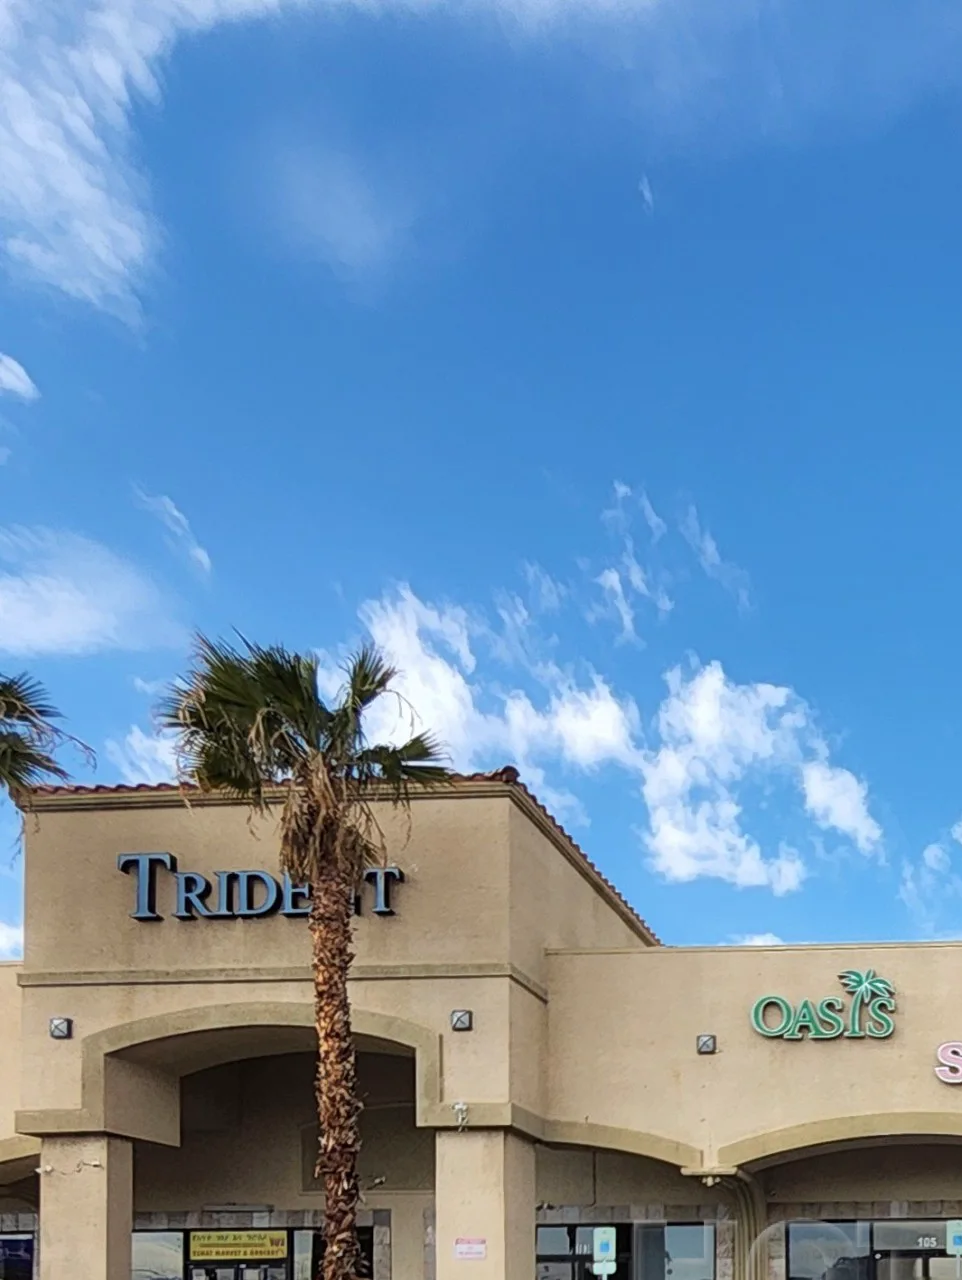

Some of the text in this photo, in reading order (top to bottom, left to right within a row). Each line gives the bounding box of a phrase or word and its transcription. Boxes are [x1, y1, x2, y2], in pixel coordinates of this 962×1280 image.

[117, 851, 404, 920] TRIDET
[751, 968, 896, 1039] OASIS
[917, 1236, 937, 1249] 105
